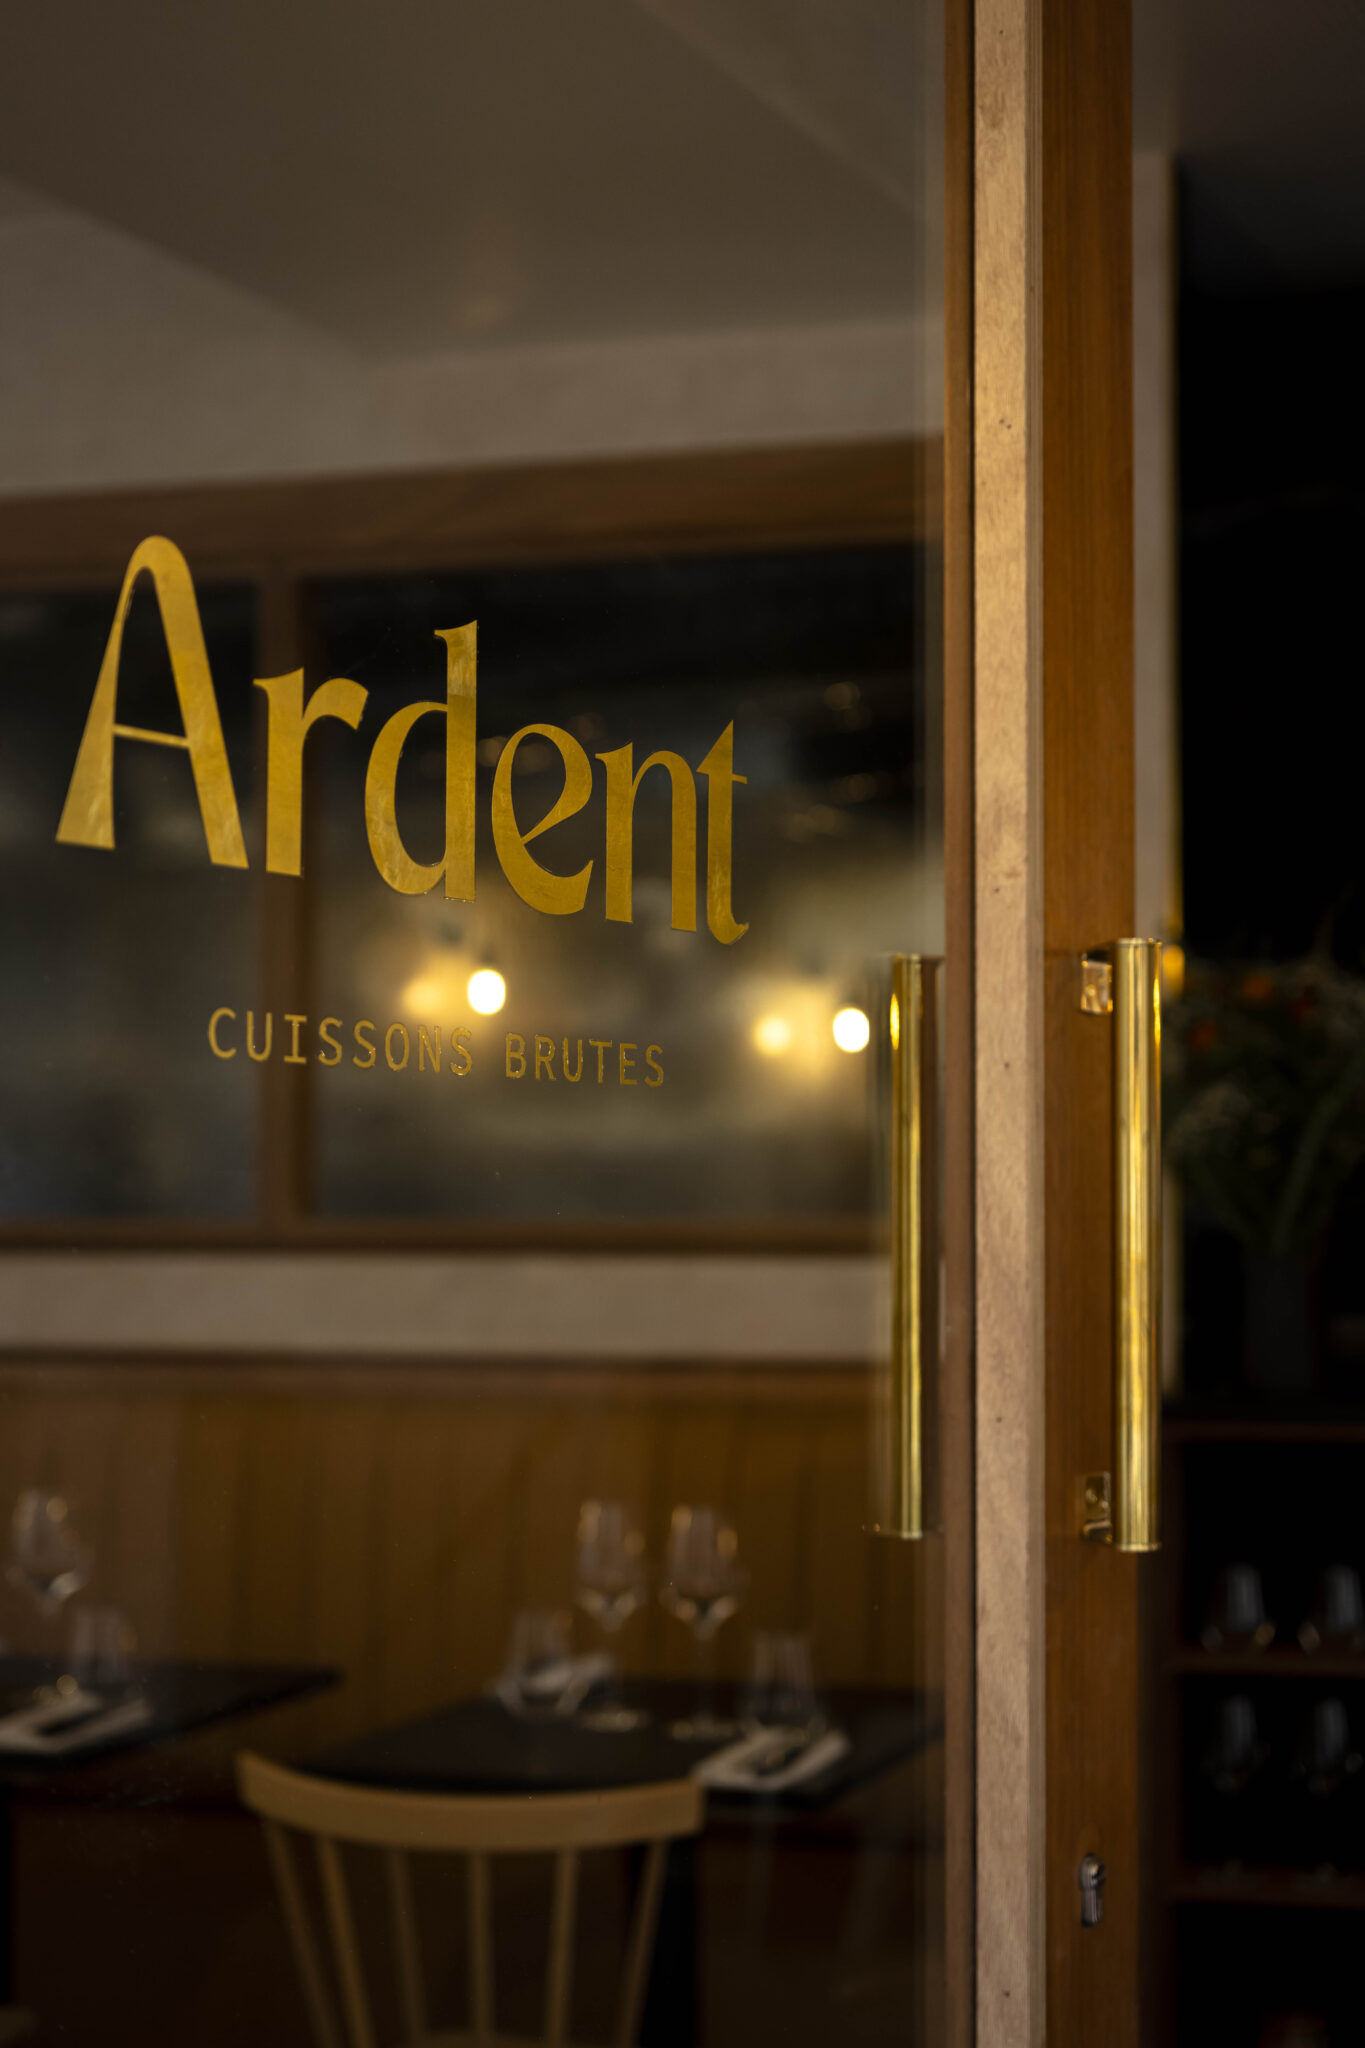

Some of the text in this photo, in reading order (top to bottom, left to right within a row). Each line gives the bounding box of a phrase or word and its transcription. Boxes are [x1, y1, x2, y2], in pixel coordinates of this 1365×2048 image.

[56, 535, 749, 945] Ardent
[208, 1007, 665, 1087] CUISSONS BRUTES
